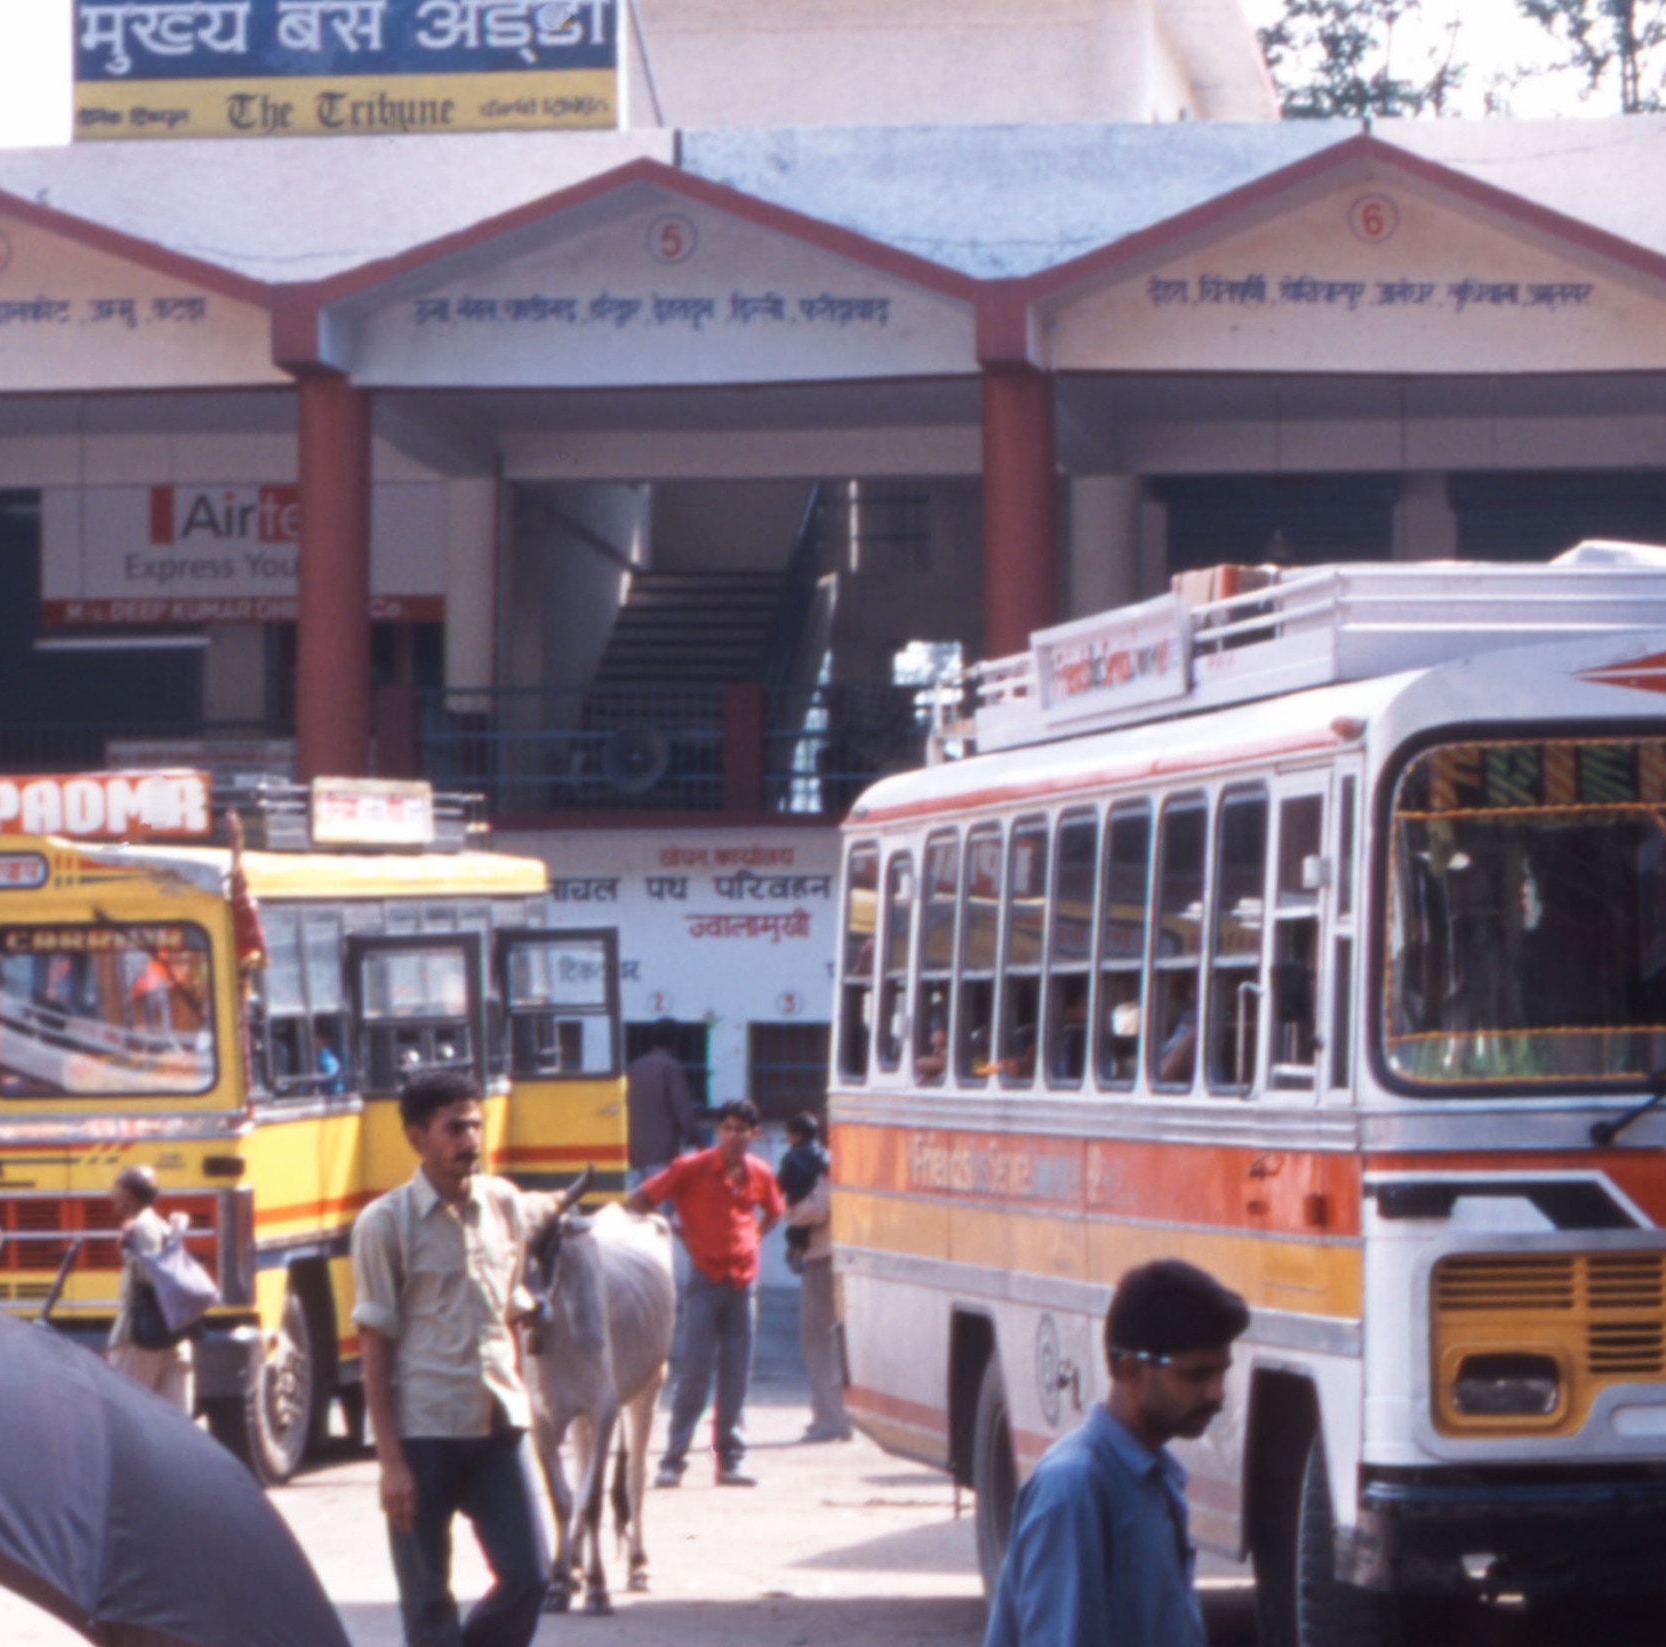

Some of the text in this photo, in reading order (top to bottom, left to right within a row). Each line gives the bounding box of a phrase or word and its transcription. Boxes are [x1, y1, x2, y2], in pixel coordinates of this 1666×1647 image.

[277, 0, 387, 52] बस
[227, 90, 456, 130] The Tribune
[1361, 203, 1383, 237] 6
[660, 225, 684, 258] 5
[180, 490, 300, 539] Airte
[124, 552, 300, 586] Express You
[110, 600, 168, 622] DEEP
[171, 598, 251, 621] KUMAR
[646, 876, 689, 903] पथ
[714, 869, 833, 903] परिवहन
[684, 906, 811, 946] ज्वालामुखी
